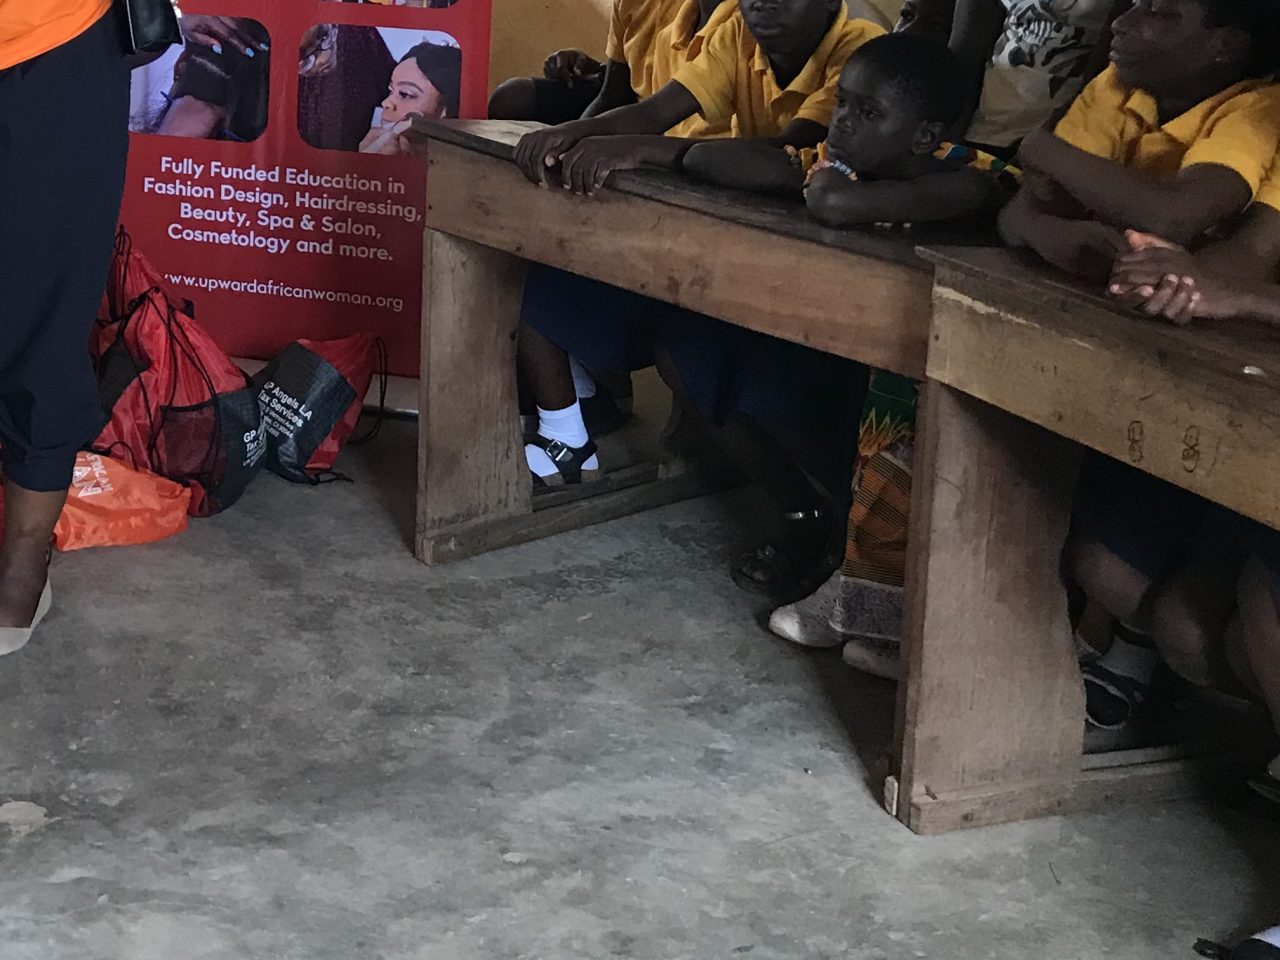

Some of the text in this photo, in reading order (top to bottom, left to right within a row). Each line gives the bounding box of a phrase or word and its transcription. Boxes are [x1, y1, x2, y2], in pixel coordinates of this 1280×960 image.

[161, 156, 405, 194] Fully Funded Education in
[144, 178, 422, 222] Fashion Design, Hairdressing,
[180, 202, 382, 239] Beauty, Spa & Salon,
[168, 224, 394, 261] Cosmetology and more.
[270, 398, 304, 427] Services
[272, 386, 300, 409] Angels
[299, 404, 312, 421] LA
[244, 430, 256, 442] GP
